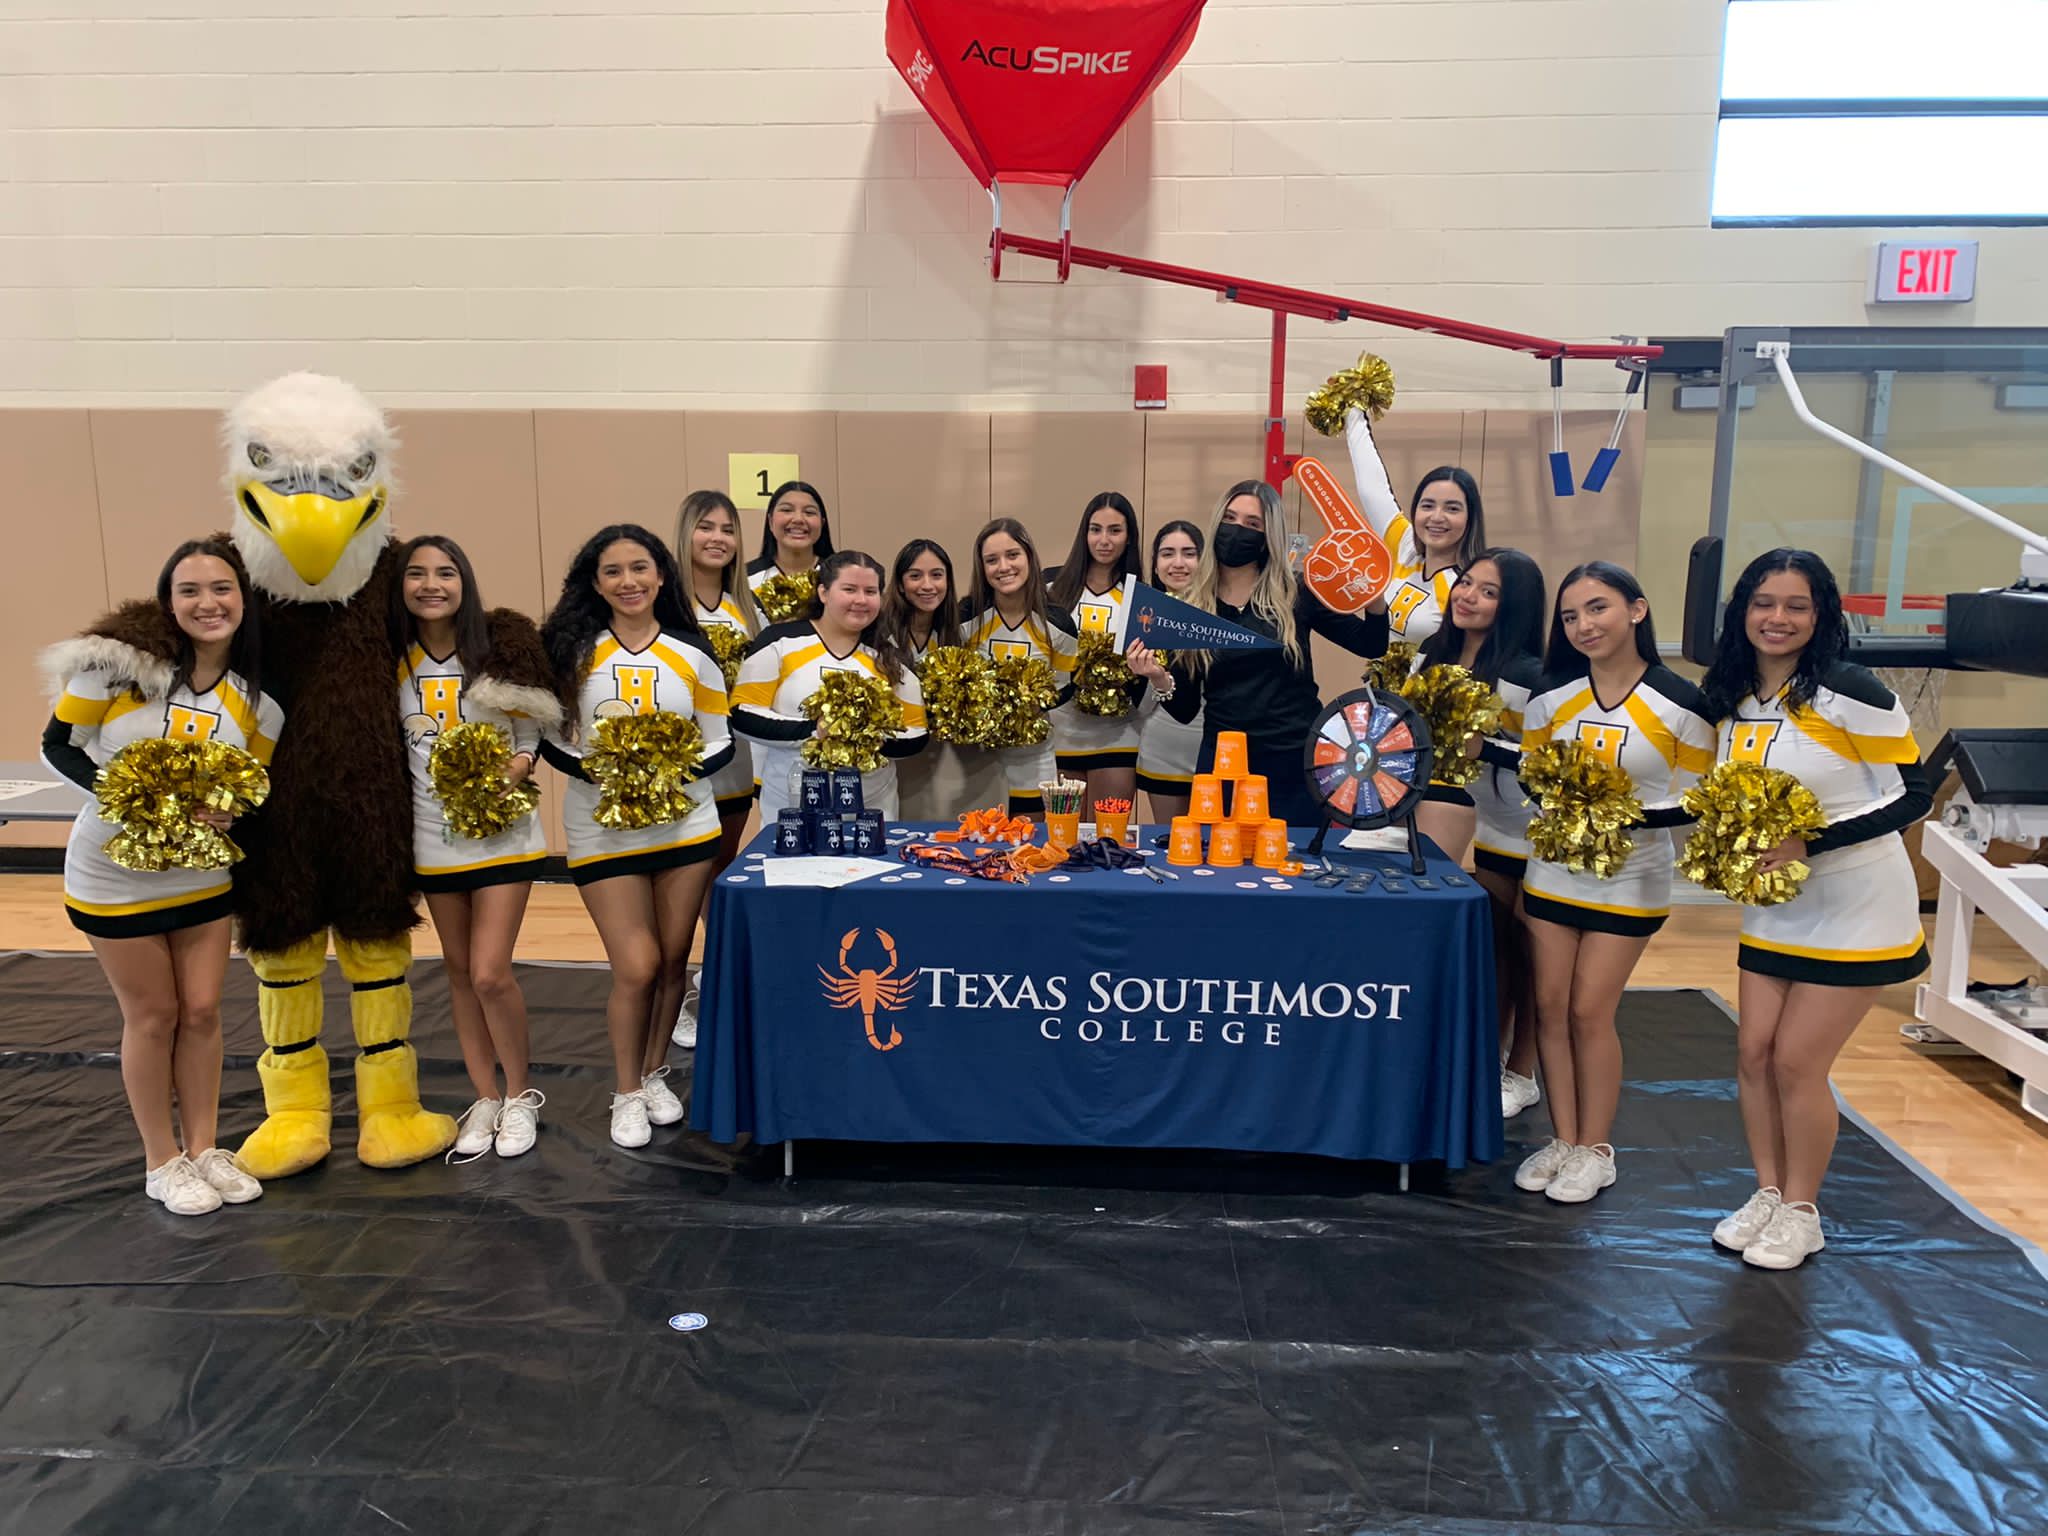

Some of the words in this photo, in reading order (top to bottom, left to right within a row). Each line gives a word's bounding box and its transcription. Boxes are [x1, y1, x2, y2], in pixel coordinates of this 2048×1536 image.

[1896, 248, 1958, 295] EXIT
[756, 469, 774, 497] 1
[1388, 581, 1431, 636] H
[417, 674, 465, 733] H
[613, 664, 659, 716] H
[918, 967, 1067, 1012] TEXAS
[1088, 971, 1410, 1021] SOUTHMOST
[1040, 1017, 1281, 1046] COLLEGE
